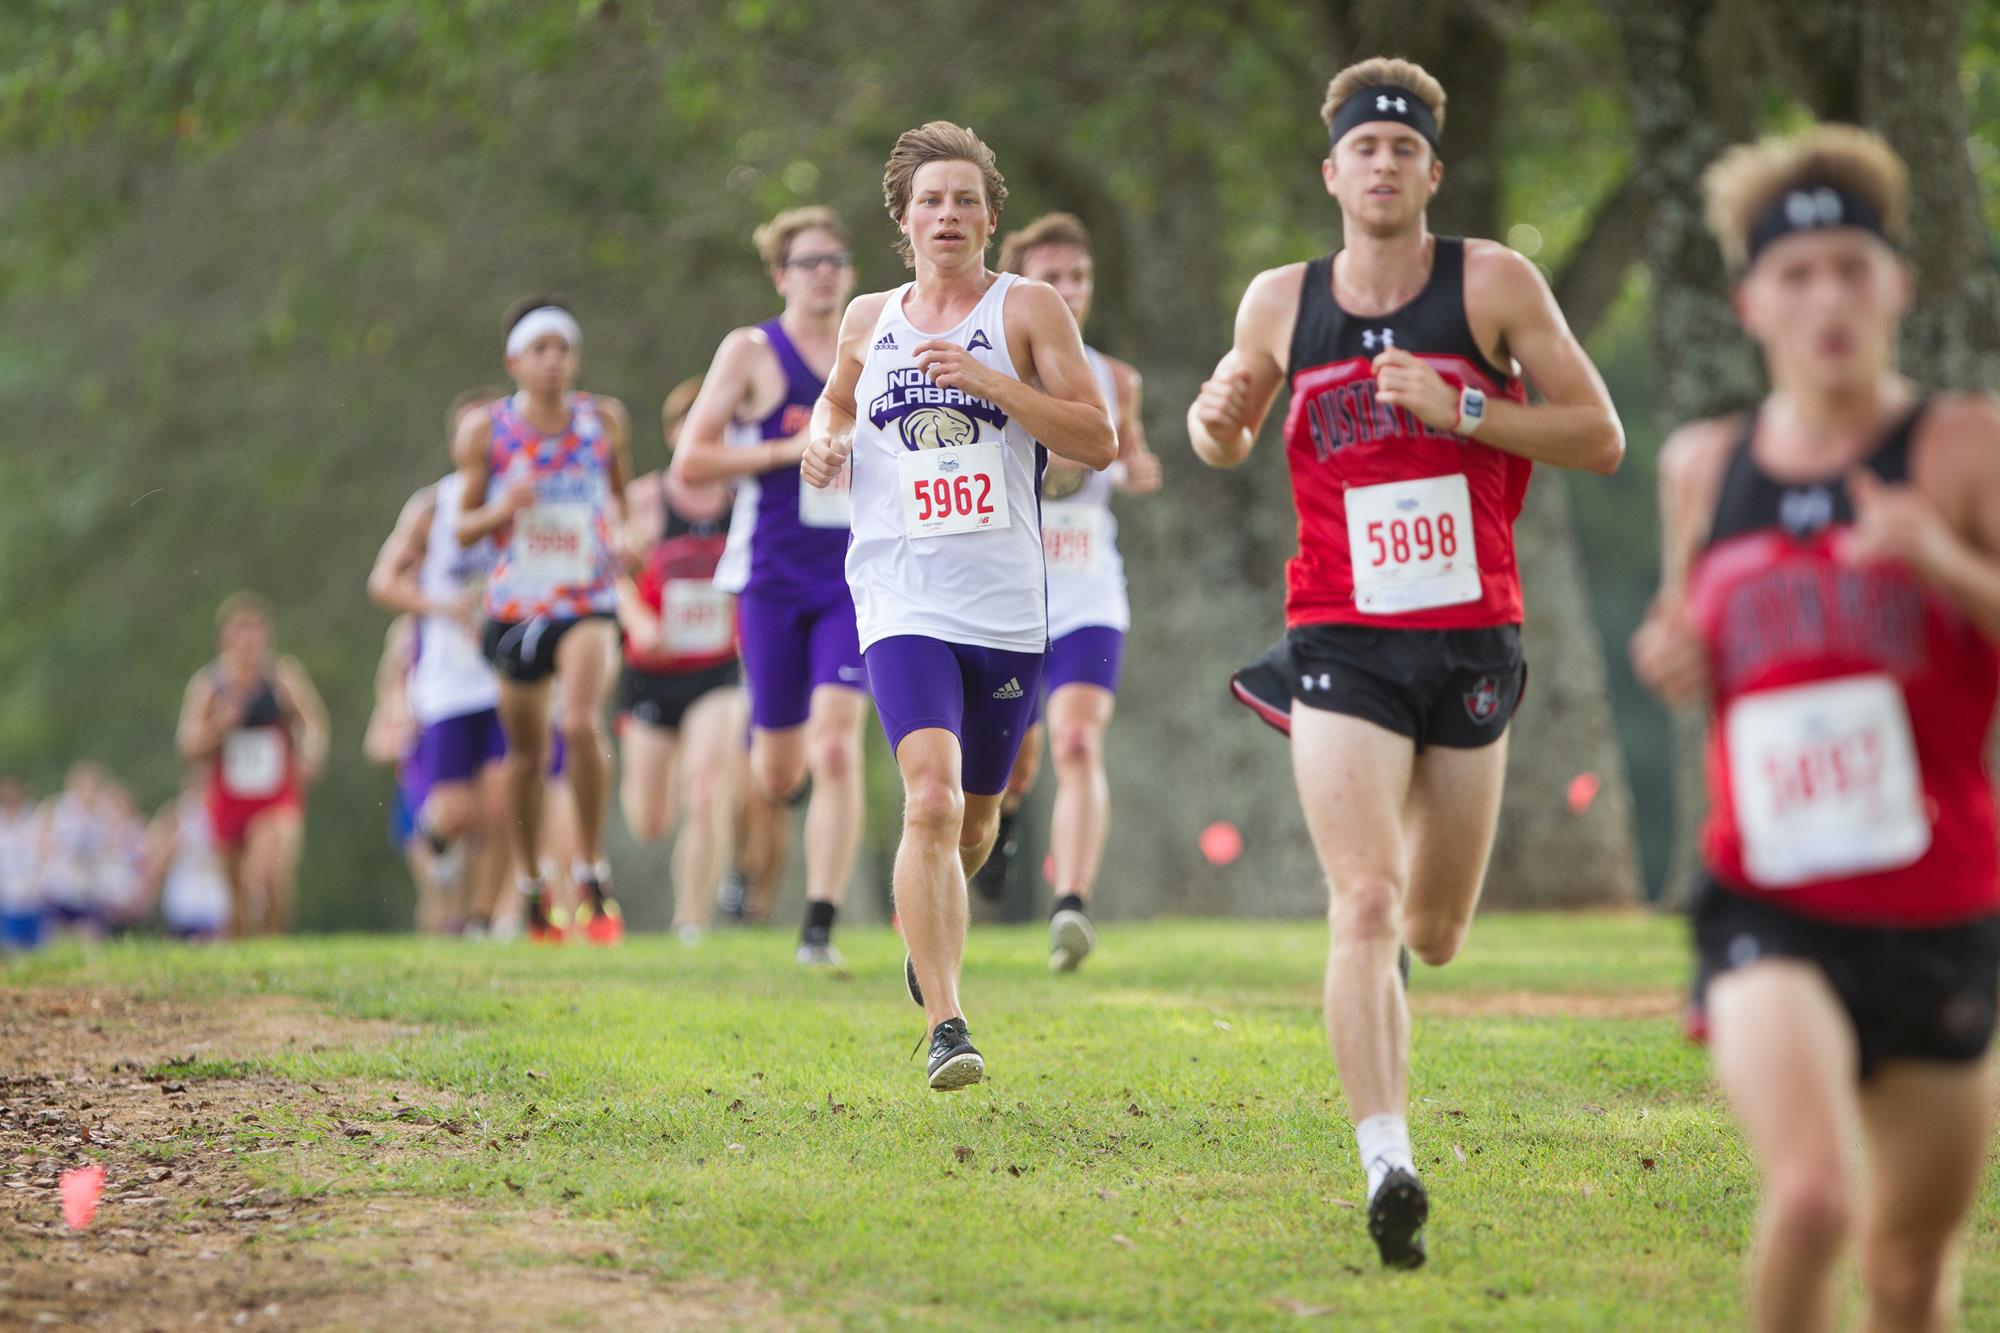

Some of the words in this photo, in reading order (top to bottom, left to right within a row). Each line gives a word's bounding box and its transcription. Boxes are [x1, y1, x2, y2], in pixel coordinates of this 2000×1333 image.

[914, 473, 994, 521] 5962
[1367, 512, 1457, 567] 5898
[992, 689, 1023, 699] adidas
